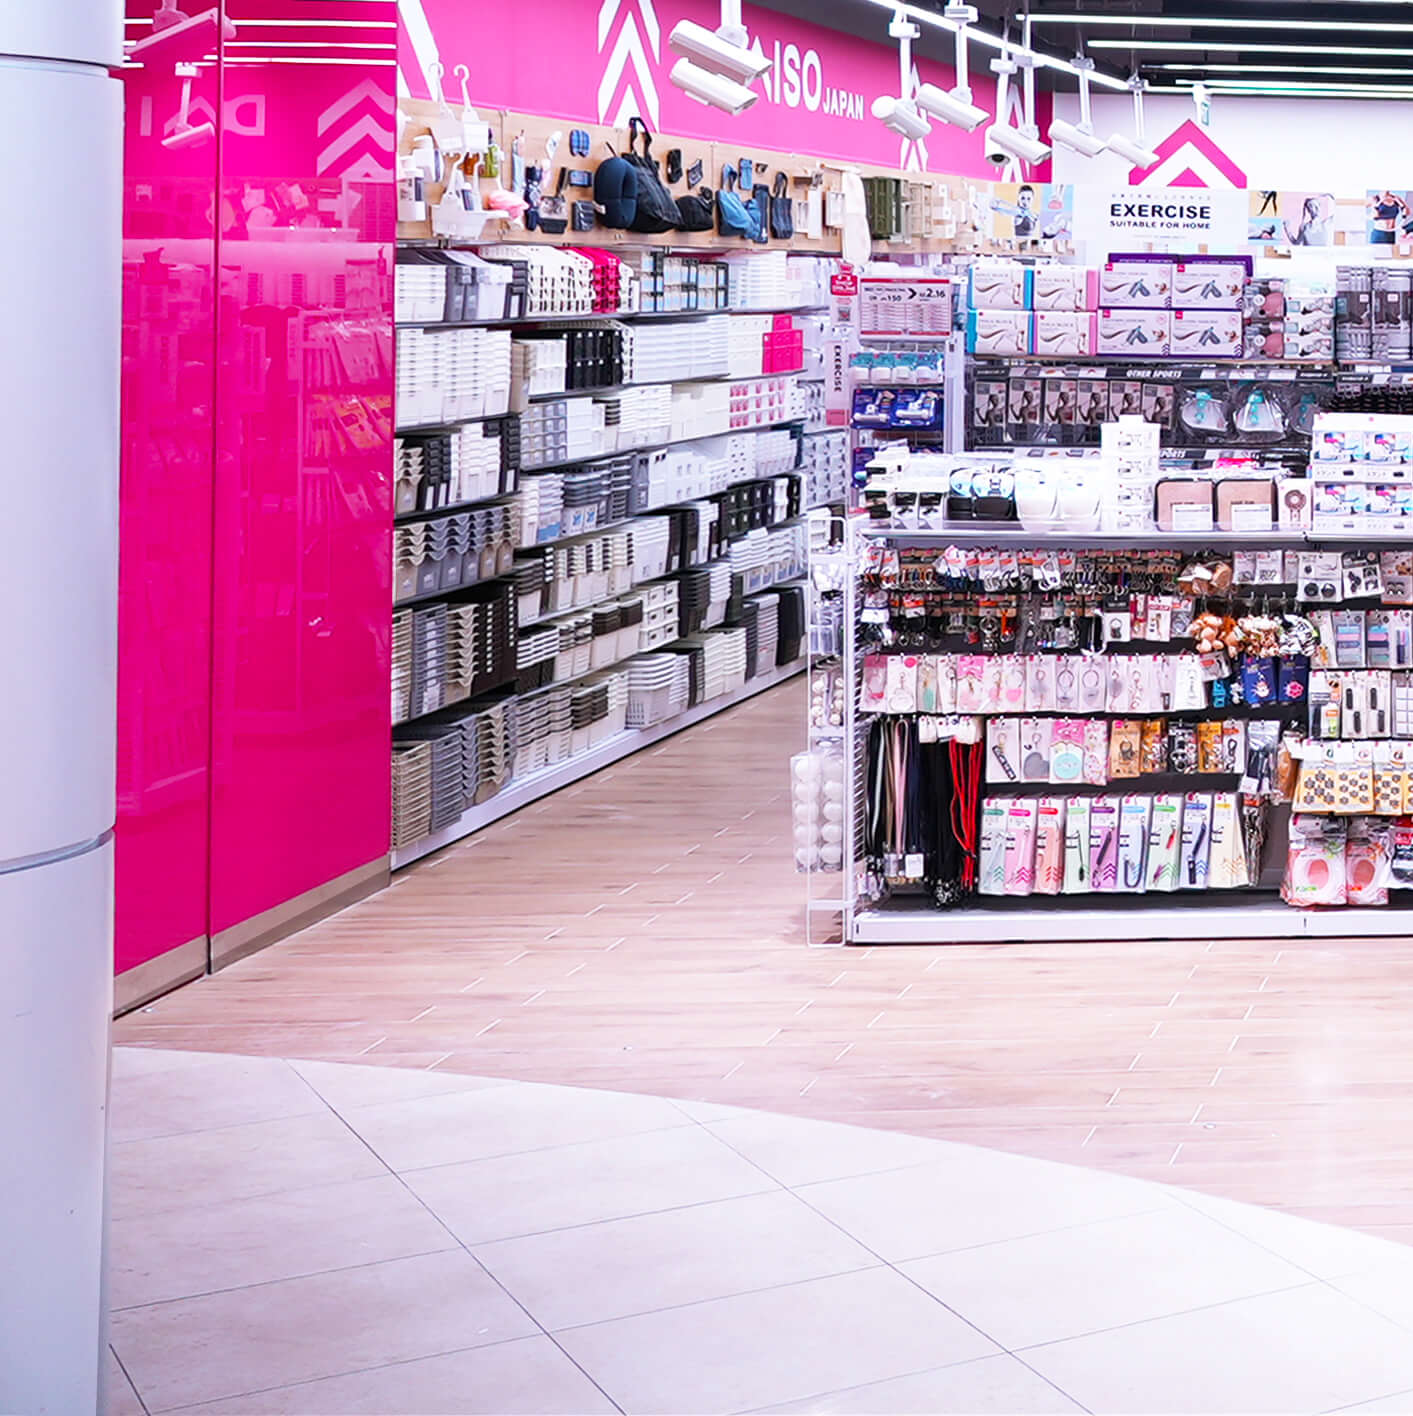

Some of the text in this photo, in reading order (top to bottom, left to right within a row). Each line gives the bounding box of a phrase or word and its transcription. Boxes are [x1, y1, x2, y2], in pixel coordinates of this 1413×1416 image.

[750, 35, 864, 120] ISO JAPAN
[1110, 203, 1211, 220] EXERCISE
[1110, 220, 1157, 229] SUITABLE
[1182, 222, 1211, 230] HOME
[833, 345, 842, 392] EXERCISE
[1126, 369, 1182, 379] OTHER SPORTS
[1160, 449, 1186, 459] PORTS
